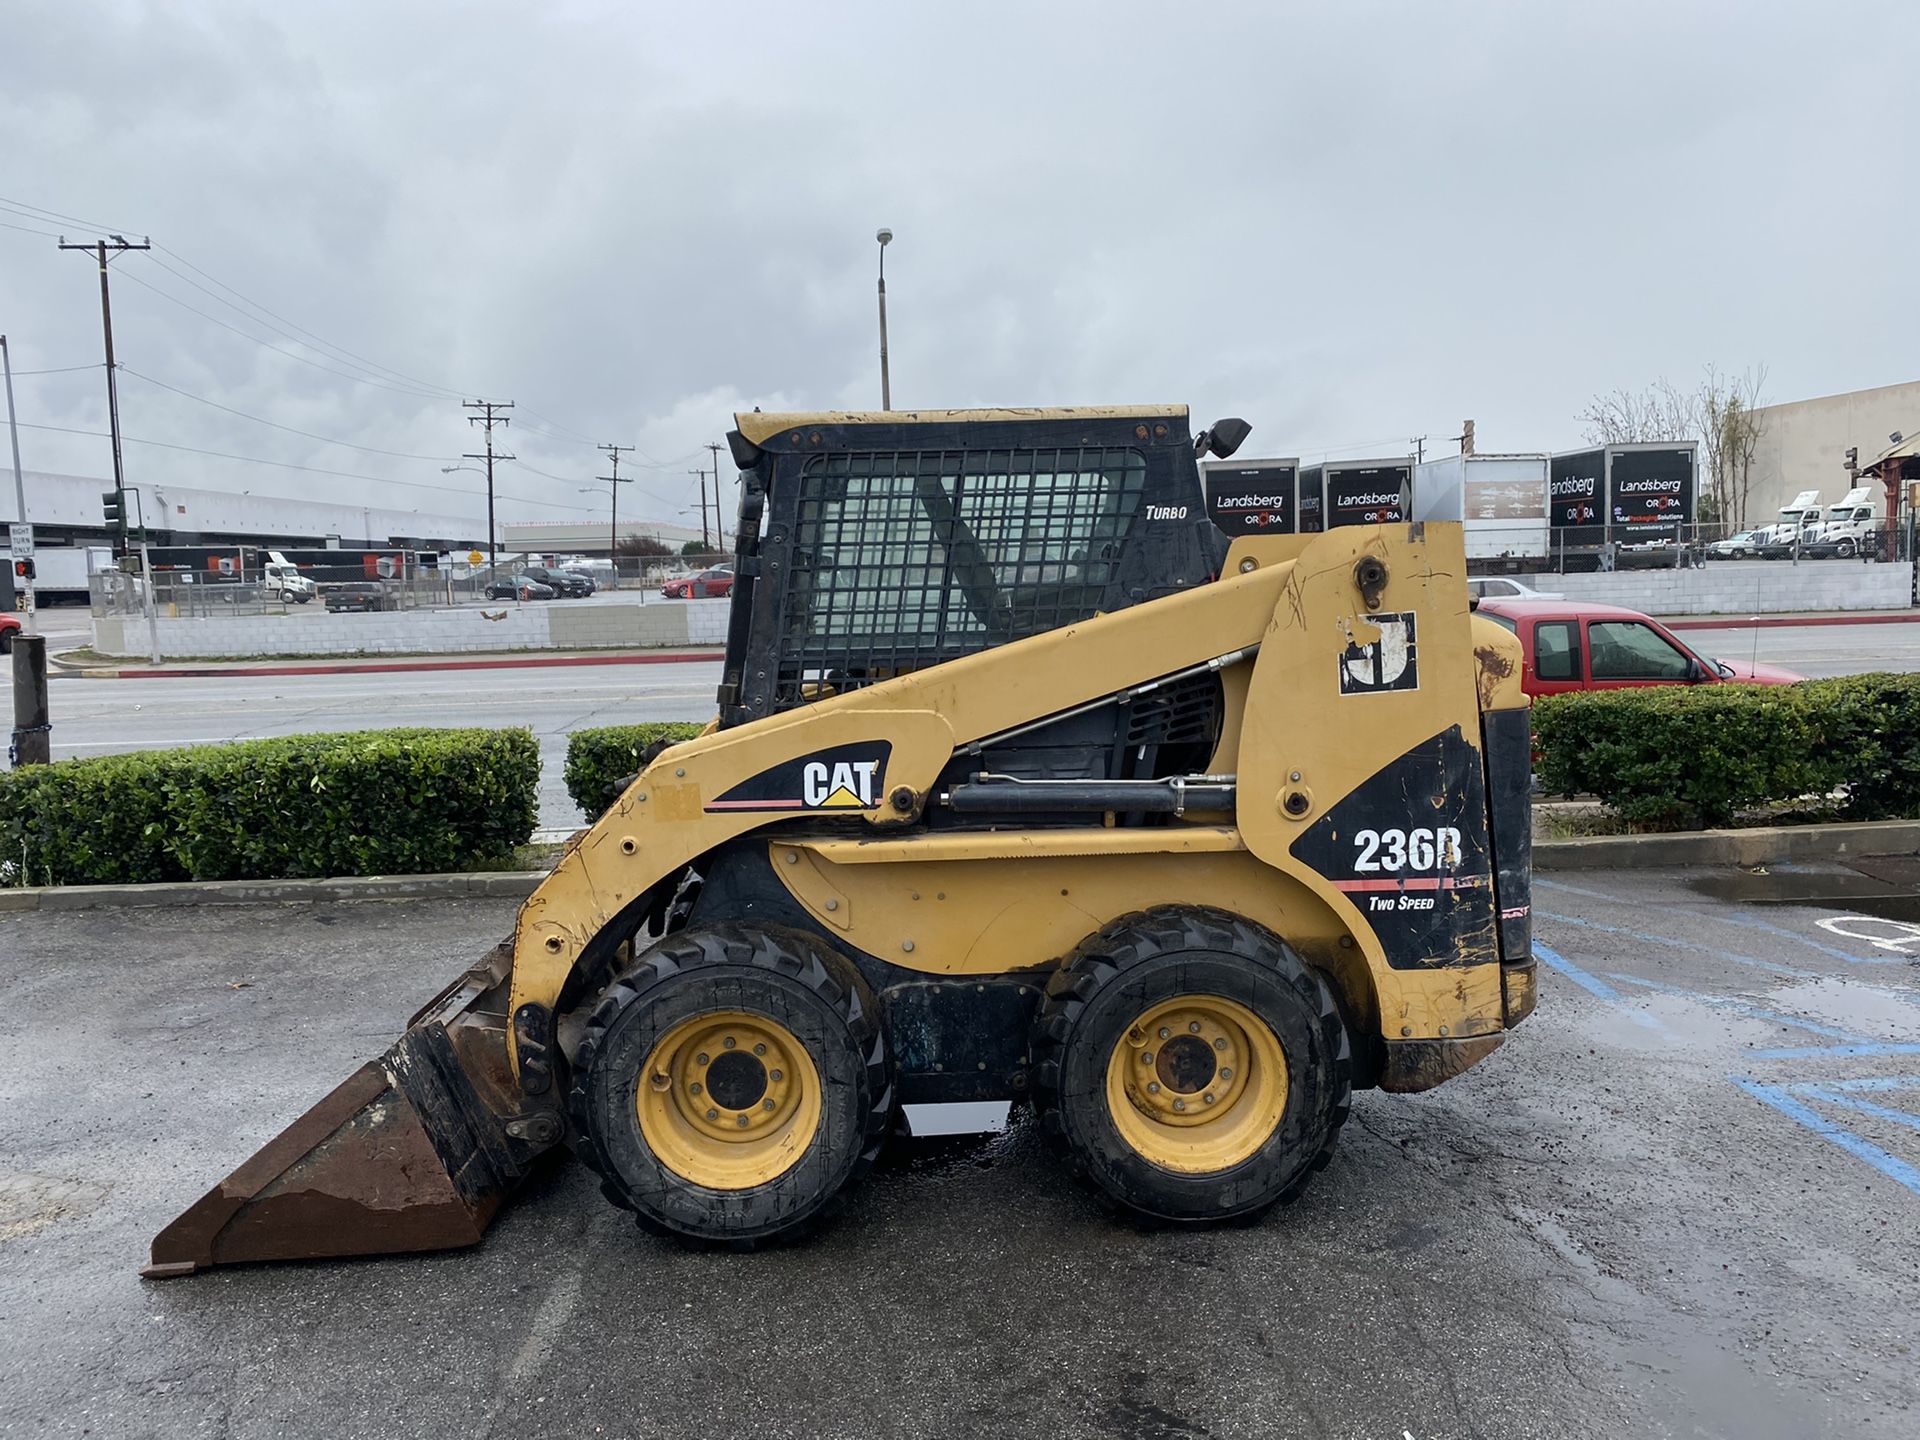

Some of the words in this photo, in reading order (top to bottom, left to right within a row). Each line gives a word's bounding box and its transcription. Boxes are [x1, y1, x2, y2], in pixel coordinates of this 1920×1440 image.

[1551, 475, 1595, 496] andsberg
[1620, 479, 1682, 493] Landsberg
[1217, 494, 1283, 509] Landsberg
[1337, 492, 1400, 506] Landsberg
[1645, 497, 1681, 509] ORORA
[1146, 505, 1187, 520] TURBO
[1244, 513, 1283, 526] ORORA
[1364, 510, 1400, 522] ORORA
[1566, 504, 1595, 522] ORORA
[14, 546, 32, 554] ONLY
[803, 761, 877, 807] CAT
[1353, 827, 1462, 872] 236B
[1369, 896, 1396, 911] TWO
[1397, 895, 1435, 911] SPEED
